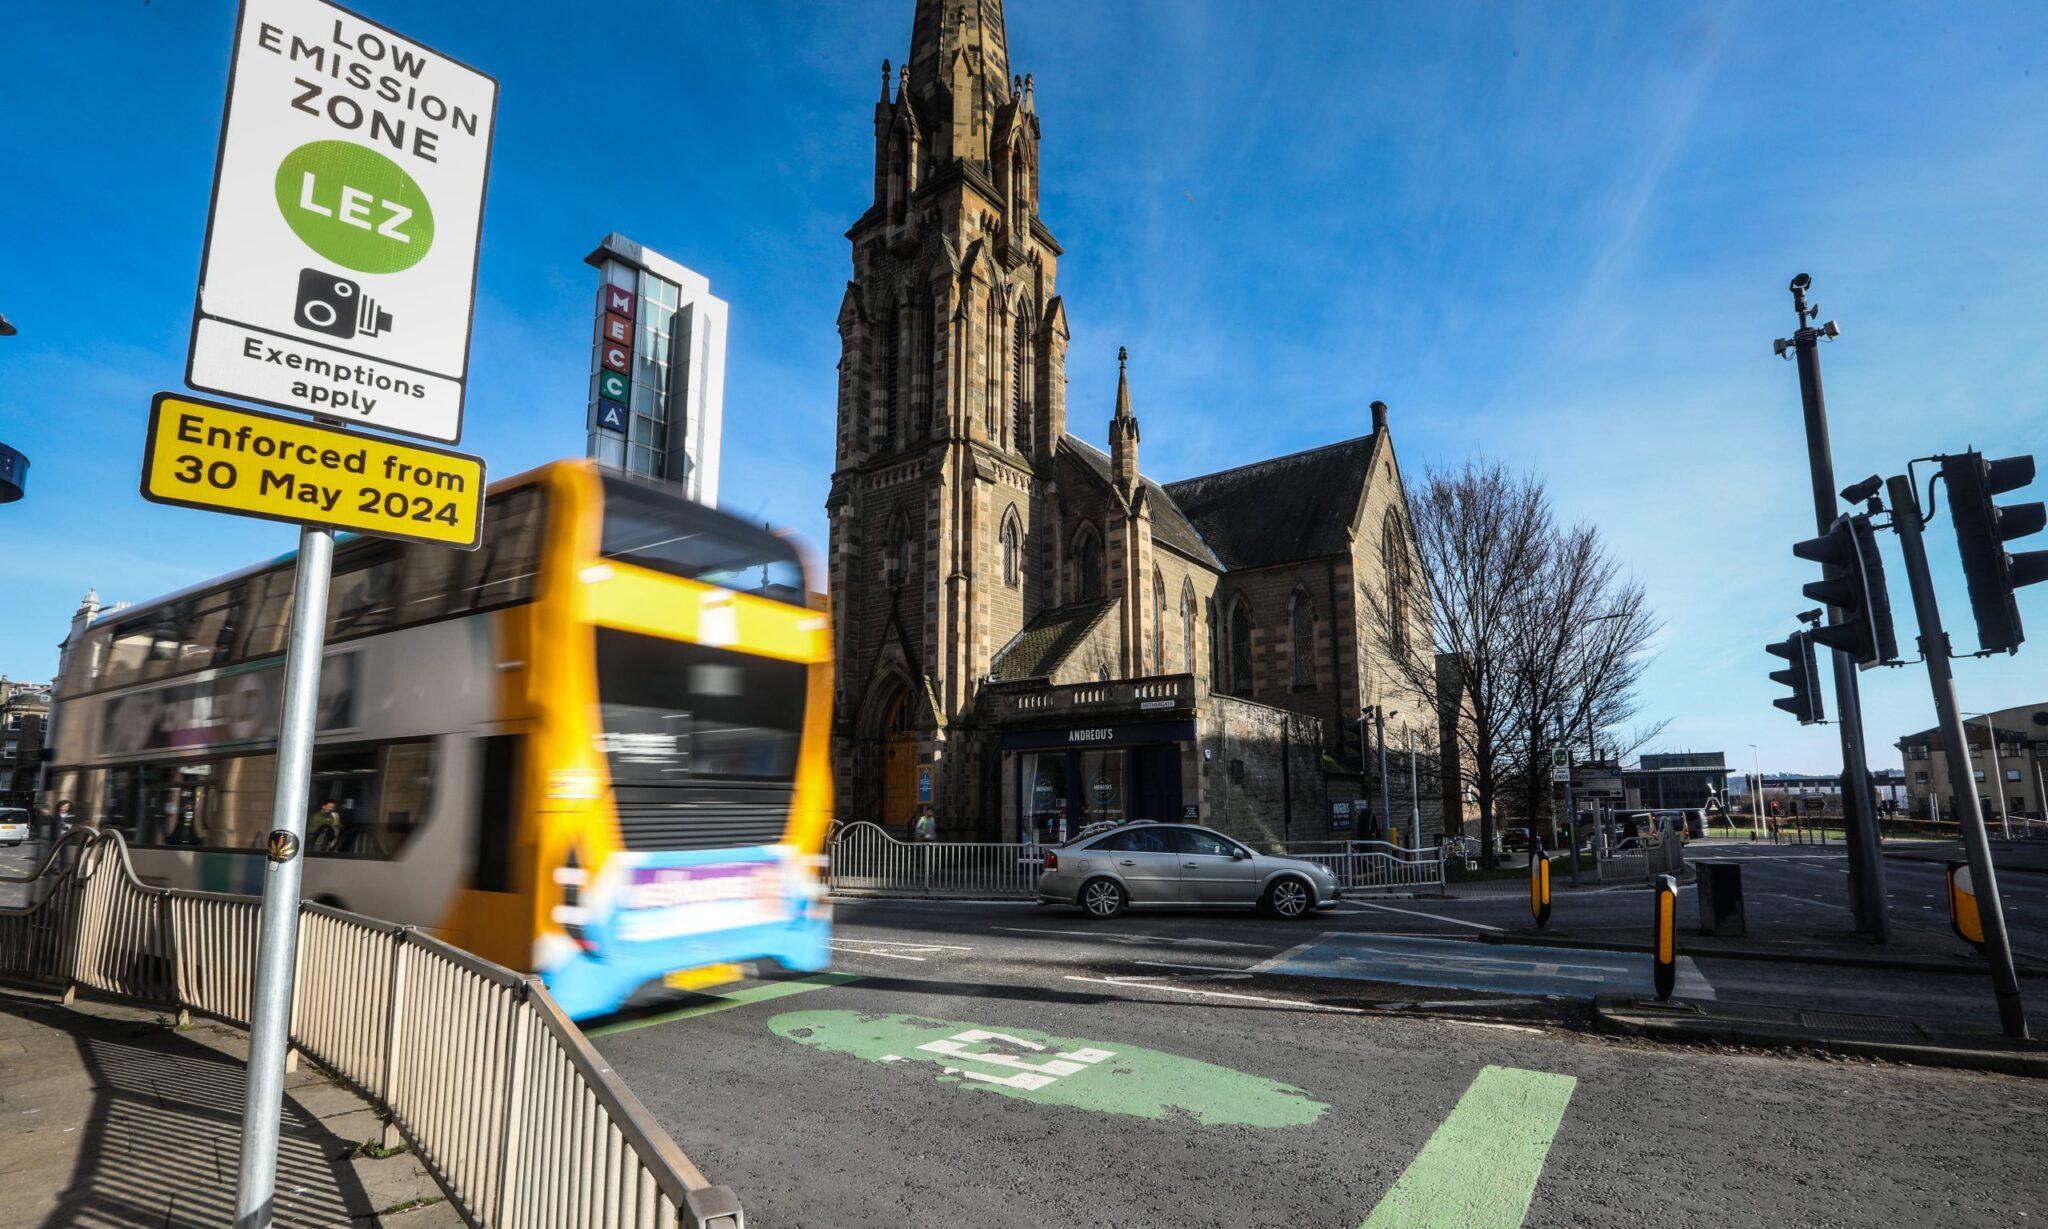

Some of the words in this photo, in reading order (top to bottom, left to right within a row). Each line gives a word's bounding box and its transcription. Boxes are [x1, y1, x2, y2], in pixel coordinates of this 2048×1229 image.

[258, 21, 478, 137] EMISSION
[333, 19, 426, 80] LOW
[290, 77, 439, 164] ZONE
[299, 171, 413, 244] LEZ
[243, 337, 426, 399] Exemptions
[604, 290, 631, 427] MECCA
[291, 380, 377, 416] apply
[177, 413, 367, 475] Enforced
[383, 455, 465, 493] from
[174, 454, 238, 490] 30
[259, 468, 342, 512] May
[358, 486, 459, 528] 2024
[1068, 728, 1113, 742] ANDREOU'S
